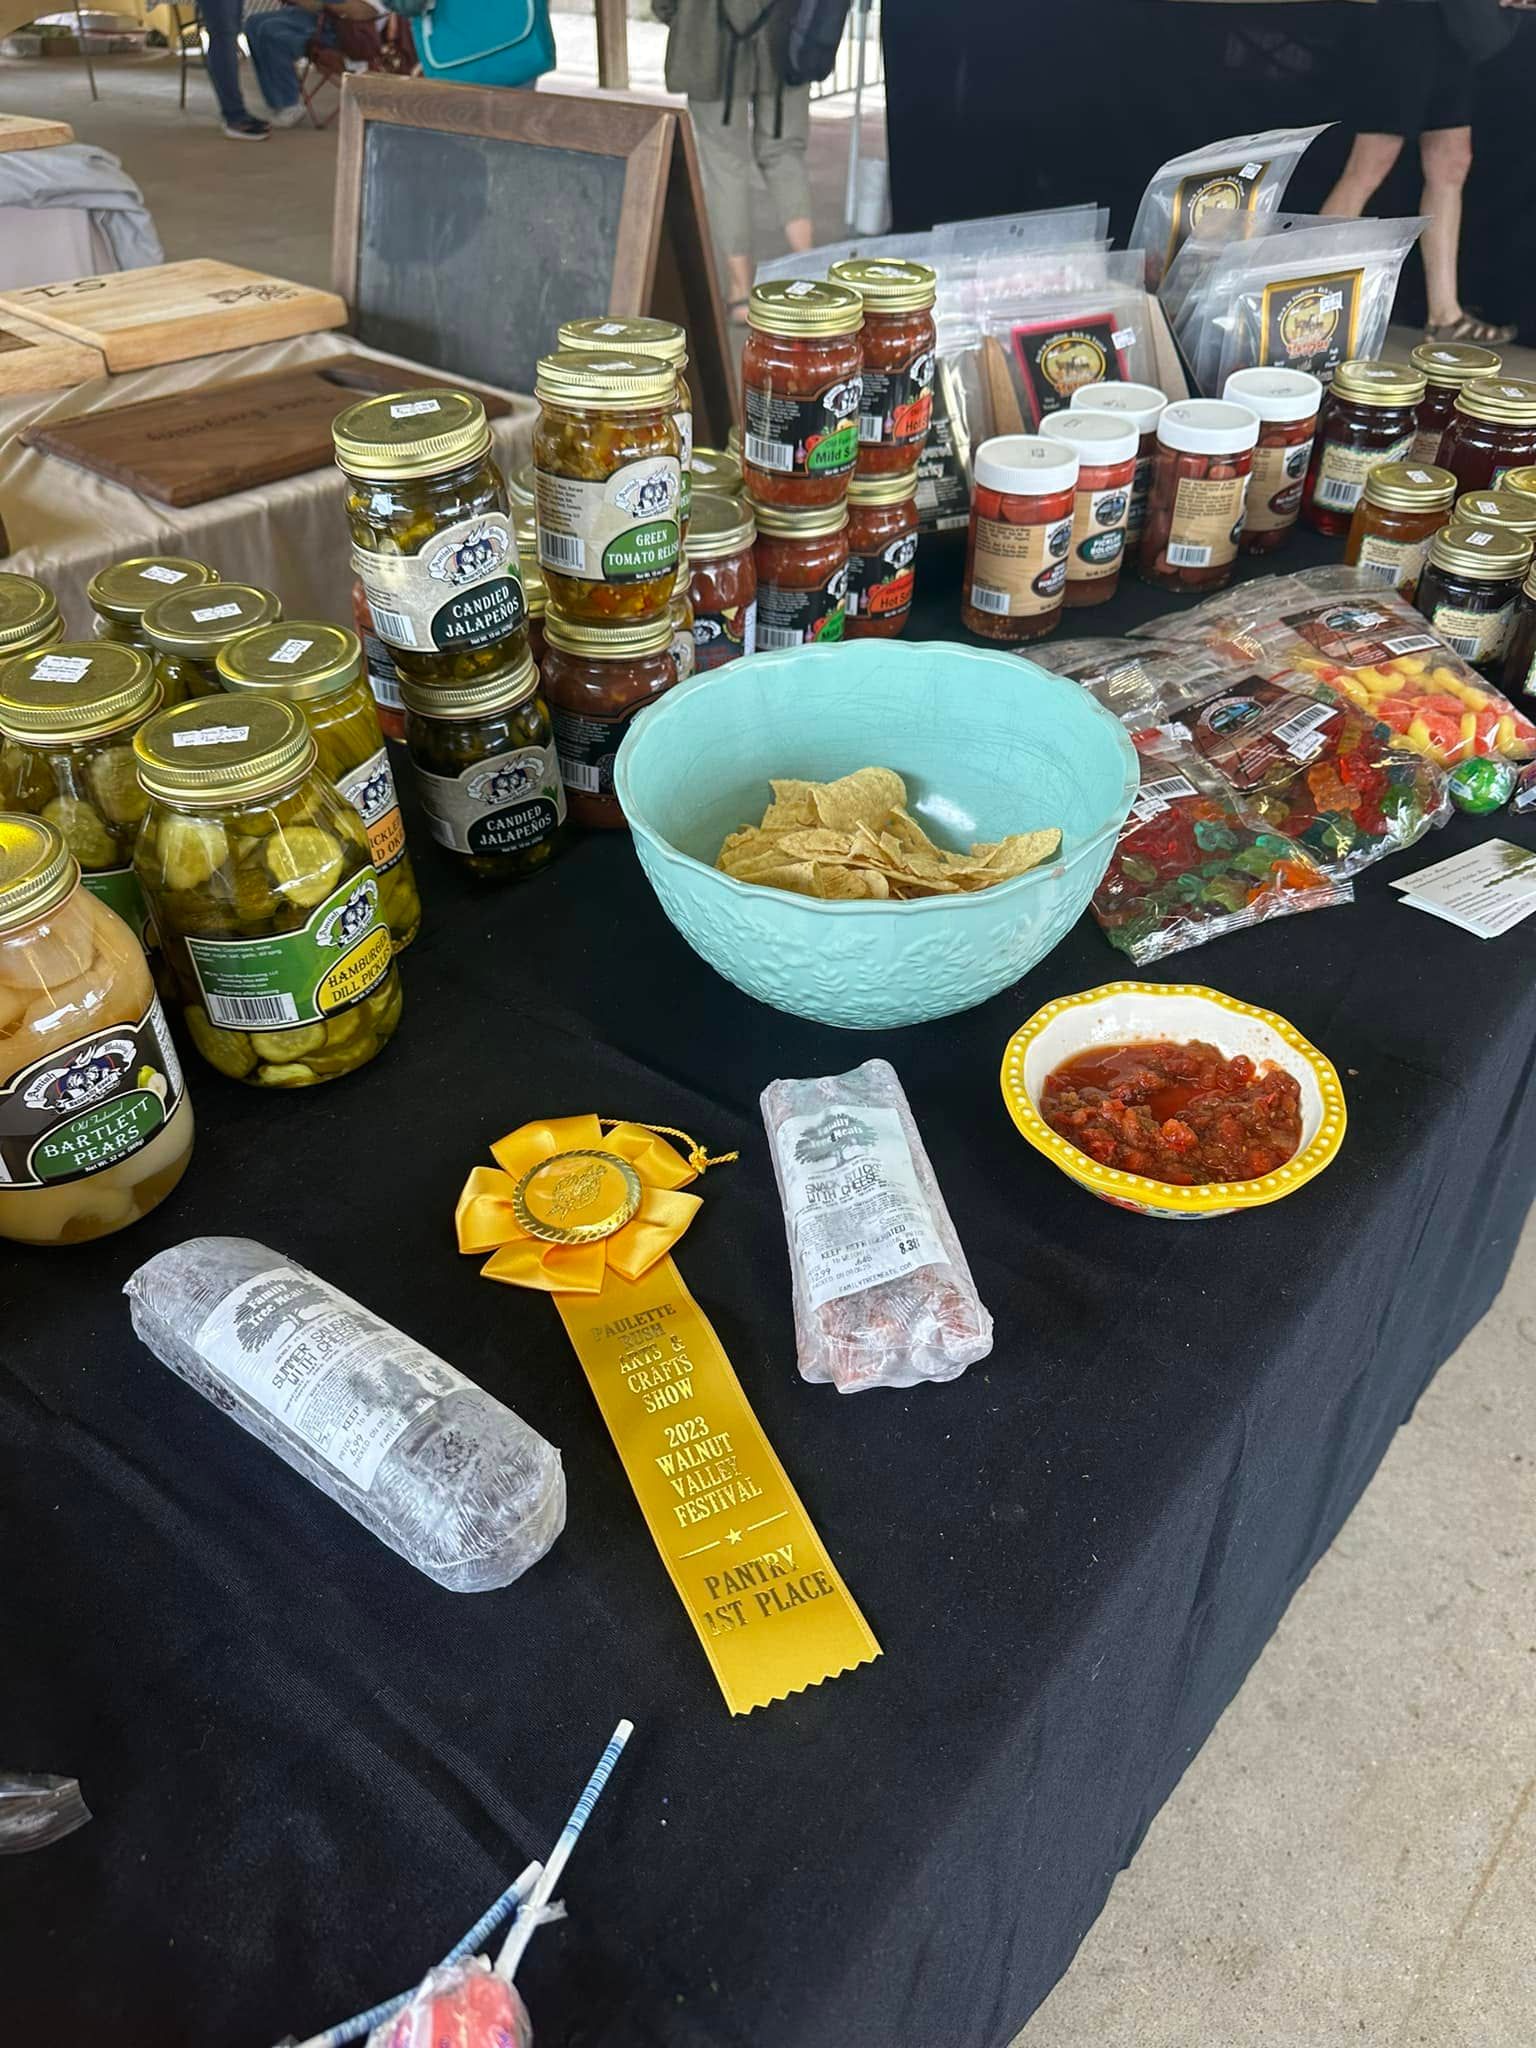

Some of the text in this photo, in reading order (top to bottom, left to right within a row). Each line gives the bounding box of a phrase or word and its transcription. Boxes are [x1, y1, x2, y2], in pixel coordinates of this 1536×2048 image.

[816, 452, 840, 464] Mild
[636, 529, 667, 546] GREEN
[608, 551, 655, 566] TOMATO
[445, 596, 519, 638] JALAPEÑOS
[453, 585, 509, 618] CANDIED
[480, 813, 552, 845] JALAPEÑOS
[486, 805, 542, 832] CANDIED
[332, 980, 361, 1003] DILL
[28, 1072, 57, 1099] Amish
[44, 1097, 149, 1157] BARTLETT
[71, 1117, 89, 1134] Old
[74, 1124, 140, 1166] PEARS
[85, 1163, 97, 1173] Net
[805, 1178, 840, 1194] SNACK
[806, 1174, 880, 1205] WITH CHEESE
[821, 1247, 841, 1260] KEEP
[249, 1283, 289, 1311] Family
[249, 1304, 277, 1330] Tree
[592, 1303, 677, 1342] PAULETTE
[618, 1322, 666, 1349] RUSH
[271, 1341, 311, 1390] SUMMER
[288, 1353, 317, 1388] WITH
[619, 1335, 686, 1374] ARTS &
[627, 1354, 694, 1394] CRAFTS
[643, 1377, 694, 1414] SHOW
[342, 1406, 360, 1432] KEEP
[664, 1416, 709, 1448] 2023
[656, 1432, 734, 1477] WALNUT
[670, 1456, 742, 1499] VALLEY
[673, 1477, 763, 1527] FESTIVAL
[704, 1544, 799, 1600] PANTRY
[704, 1570, 834, 1636] 1ST PLACE
